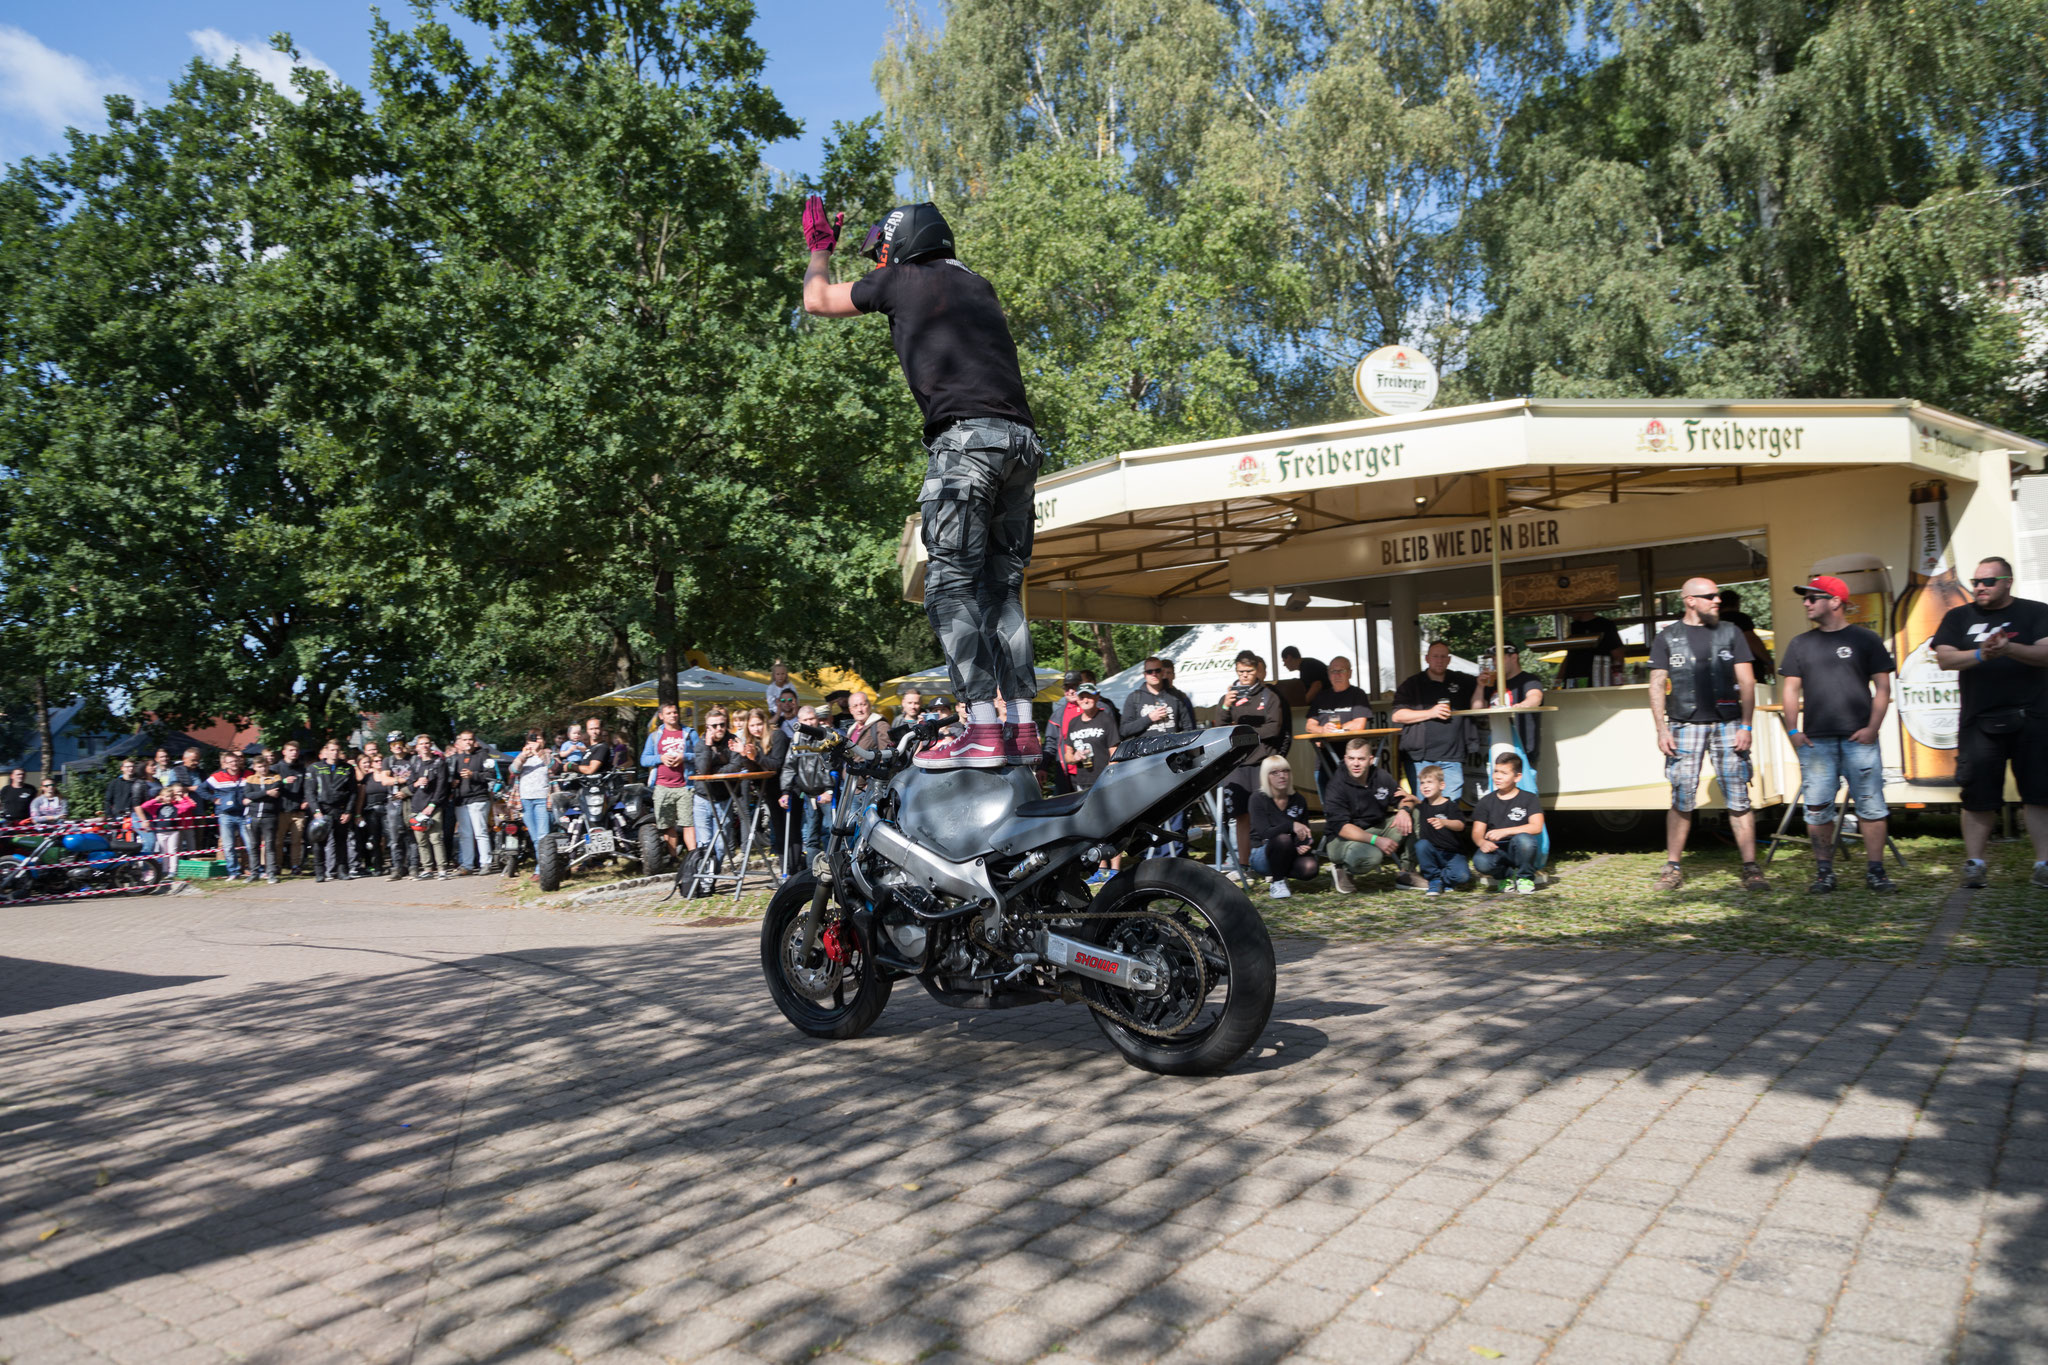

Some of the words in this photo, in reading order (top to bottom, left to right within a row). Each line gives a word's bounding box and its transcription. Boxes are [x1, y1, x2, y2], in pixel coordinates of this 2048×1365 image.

[1376, 374, 1426, 392] Freiberger
[1682, 420, 1804, 458] Freiberger
[1276, 442, 1404, 482] Freiberger
[1381, 535, 1429, 566] BLEIB
[1433, 530, 1466, 558] WIE
[1471, 524, 1512, 554] DEN
[1518, 519, 1560, 549] BIER
[1179, 659, 1236, 673] Freiberg
[1901, 686, 1961, 706] Freiber
[1074, 951, 1119, 974] SHOWA
